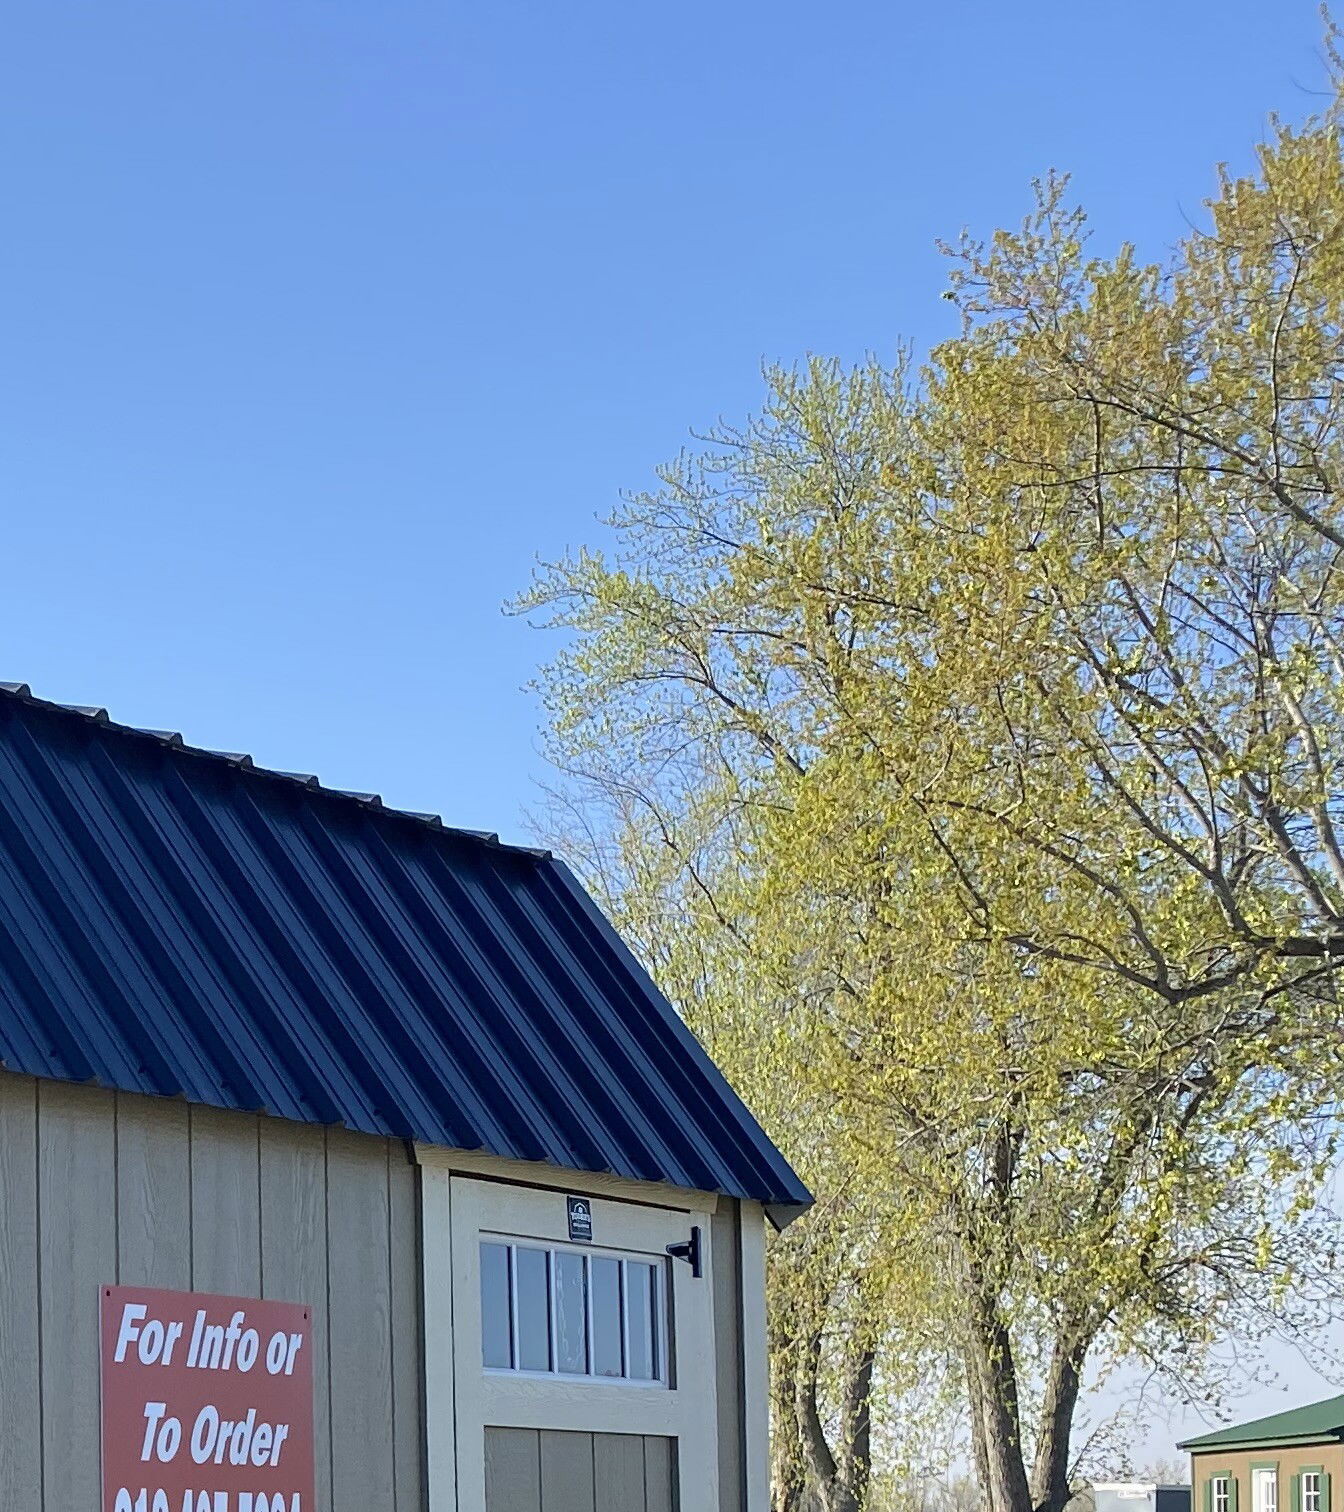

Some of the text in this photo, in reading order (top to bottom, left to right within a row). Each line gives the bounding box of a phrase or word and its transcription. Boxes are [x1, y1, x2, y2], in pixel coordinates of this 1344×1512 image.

[114, 1303, 303, 1375] For Info or
[140, 1401, 289, 1467] To Order
